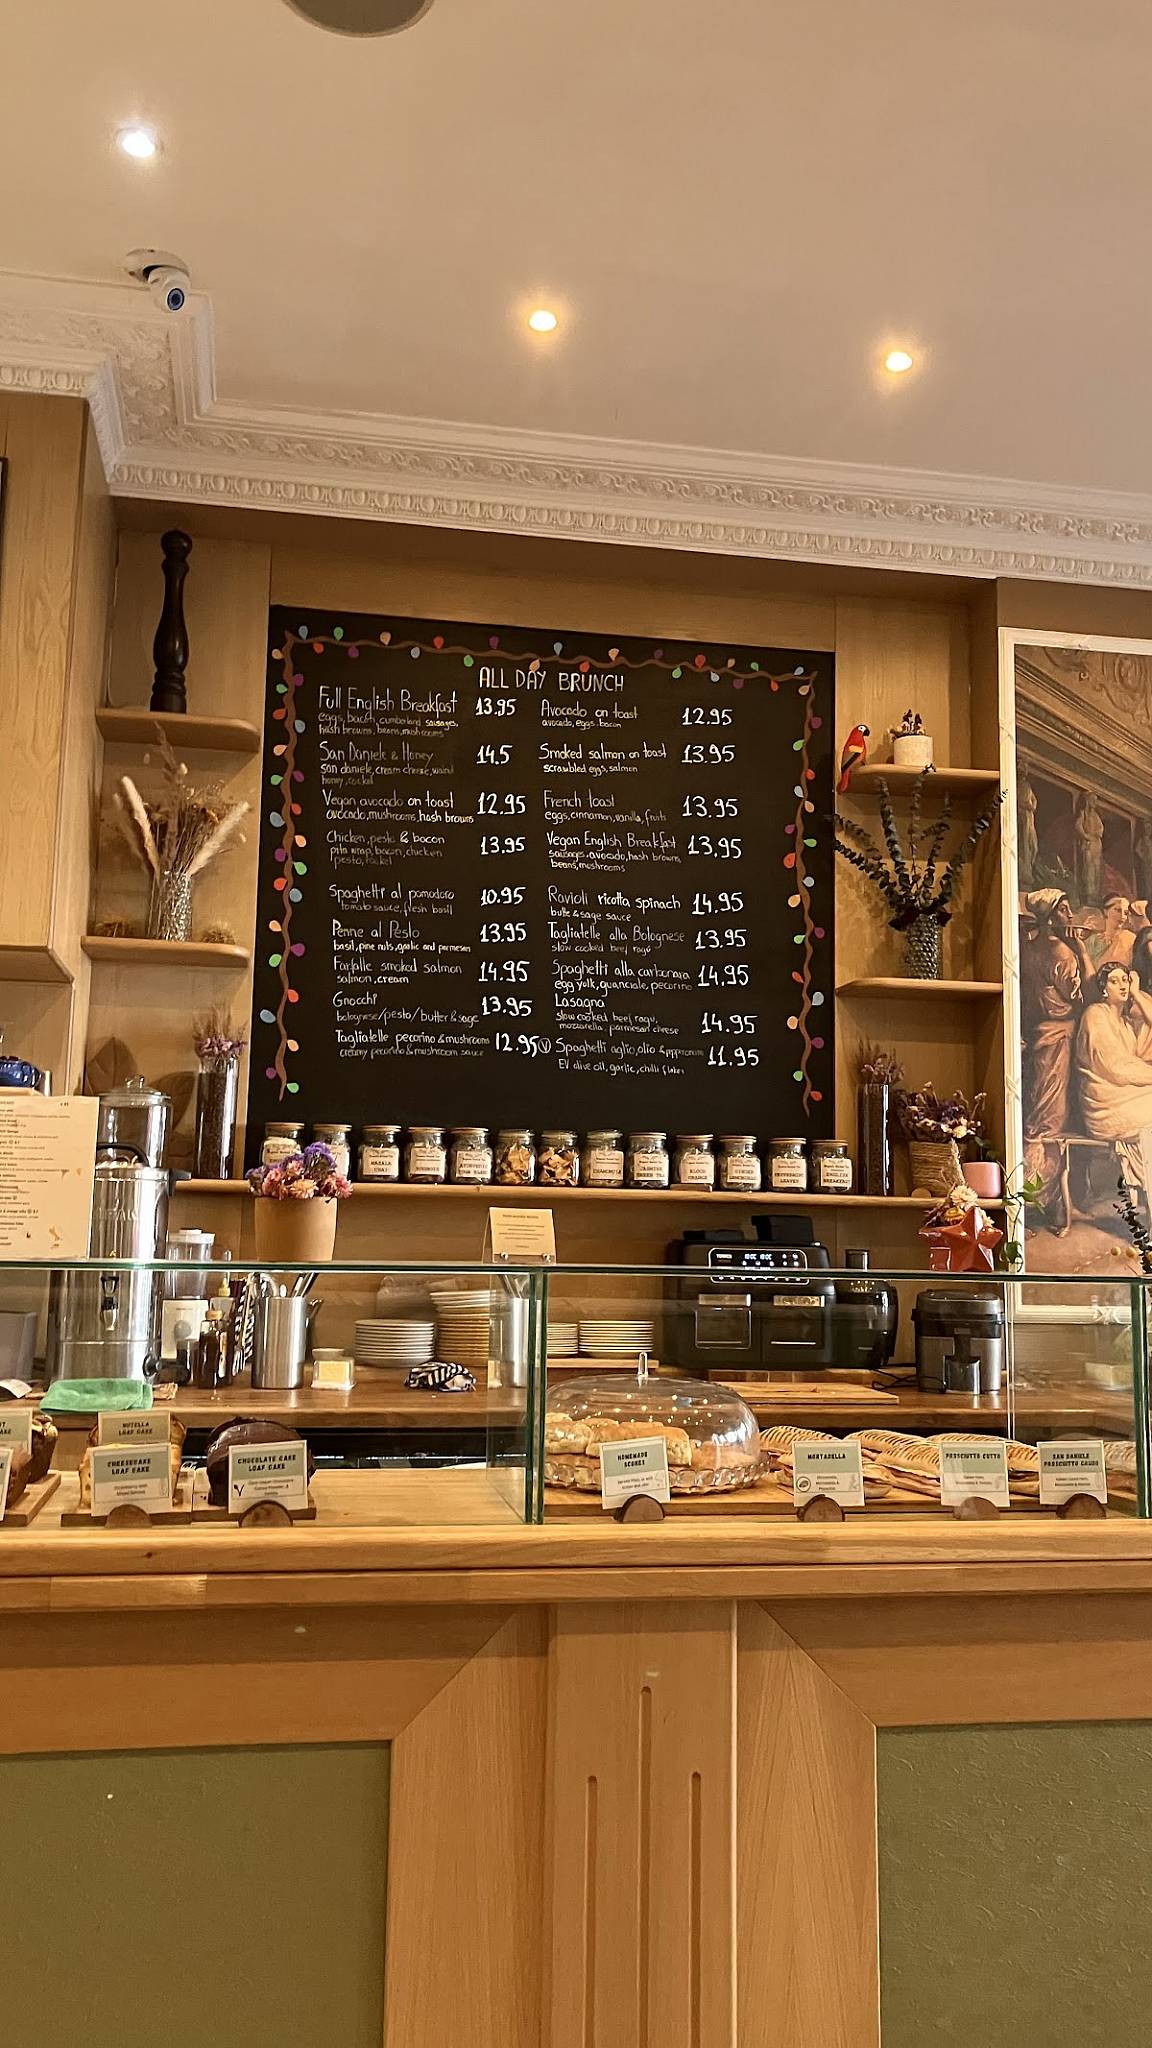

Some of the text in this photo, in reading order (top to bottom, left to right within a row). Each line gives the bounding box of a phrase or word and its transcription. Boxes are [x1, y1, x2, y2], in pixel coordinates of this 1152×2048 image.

[479, 667, 624, 692] ALL DAY BRUNCH
[319, 686, 458, 719] Full English Breakfast
[475, 697, 517, 716] 13.95
[541, 699, 638, 719] Avocado on toast
[682, 707, 733, 726] 12.95
[319, 741, 344, 761] San
[402, 742, 433, 767] Honey
[476, 745, 513, 765] 14.5
[538, 742, 582, 760] Smoked
[589, 743, 625, 760] salmon
[643, 741, 667, 758] toast
[681, 744, 736, 763] 13.95
[320, 764, 338, 774] san
[322, 789, 453, 811] Vegan avocado on toast
[477, 792, 526, 815] 12.95
[544, 789, 614, 809] French toast
[682, 795, 738, 818] 13.95
[445, 811, 474, 823] browns
[400, 831, 409, 843] &
[413, 832, 445, 844] bacon
[481, 836, 526, 855] 13.95
[547, 831, 676, 853] Vegan English Breakfast
[329, 882, 454, 907] Spaghetti al pomodoro
[481, 887, 526, 906] 10.95
[548, 885, 681, 914] Ravioli ricotta spinach
[692, 892, 744, 915] 14.95
[432, 903, 452, 914] basil
[606, 912, 632, 922] sauce
[332, 919, 419, 938] Penne al Pesto
[480, 922, 527, 942] 13.95
[547, 922, 685, 948] Tagliatelle alla Bolognese
[552, 943, 571, 952] slow
[575, 943, 604, 952] cooked
[695, 928, 747, 950] 13.95
[334, 955, 462, 974] Farfalle smoked salmon
[478, 961, 530, 982] 14.95
[552, 959, 690, 980] Spaghetti alla carbonara
[698, 964, 749, 987] 14.95
[555, 980, 692, 995] egg pecorino
[333, 991, 377, 1008] Gnocchi
[482, 996, 533, 1016] 13.95
[555, 993, 605, 1013] Lasagna
[556, 1011, 575, 1021] slow
[577, 1012, 608, 1022] cooked
[702, 1012, 758, 1034] 14.95
[335, 1029, 435, 1052] Tagliatelle pecorino
[652, 1026, 679, 1035] cheese
[495, 1032, 539, 1057] 12.95
[556, 1038, 606, 1059] Spaghetti
[707, 1045, 759, 1067] 11.95
[573, 1062, 591, 1071] olive
[107, 1458, 151, 1467] CHEESECAKE
[238, 1456, 276, 1464] CHOCOLATE
[618, 1452, 647, 1460] HOMEMADE
[112, 1467, 128, 1475] LOAF
